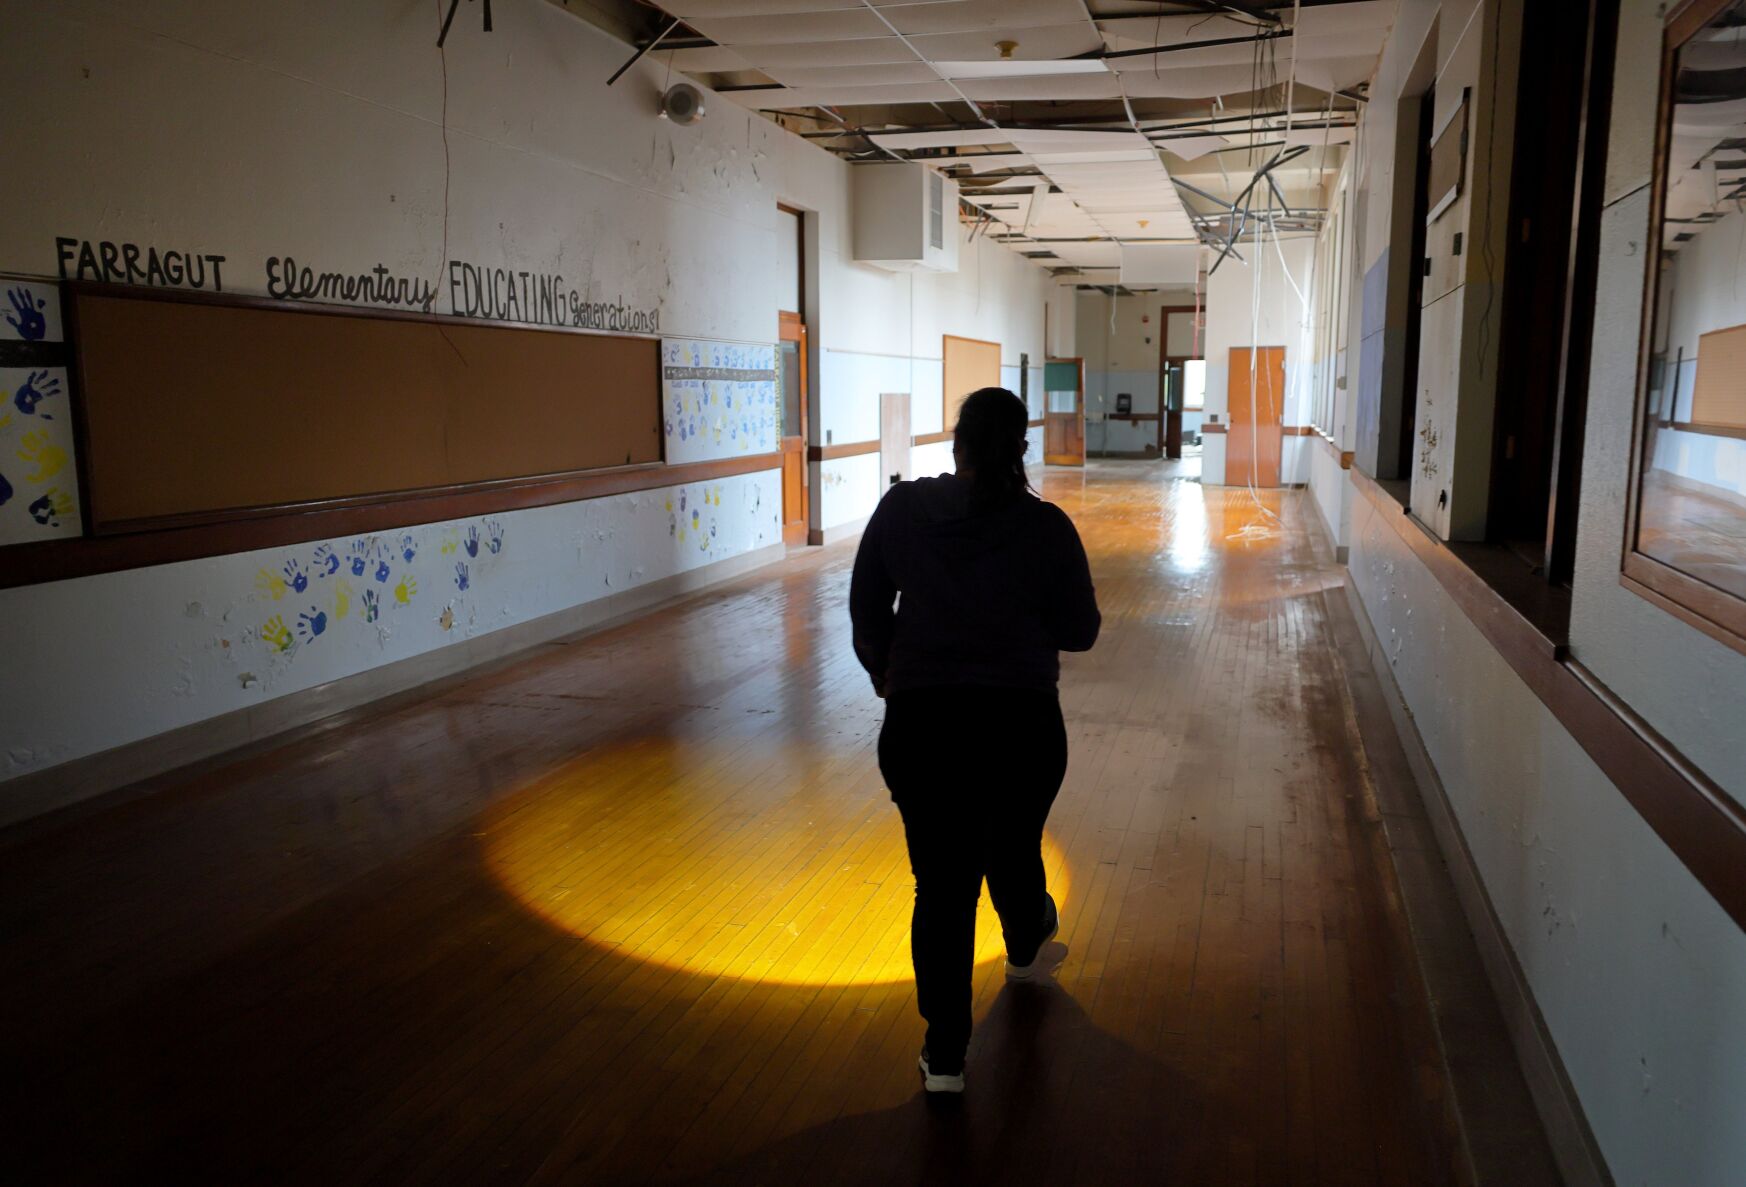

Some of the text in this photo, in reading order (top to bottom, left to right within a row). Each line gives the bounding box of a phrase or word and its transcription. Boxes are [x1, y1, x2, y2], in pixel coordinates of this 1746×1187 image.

[56, 237, 225, 291] FARRAGUT
[266, 257, 437, 312] Elementary
[449, 261, 566, 325] EDUCATING
